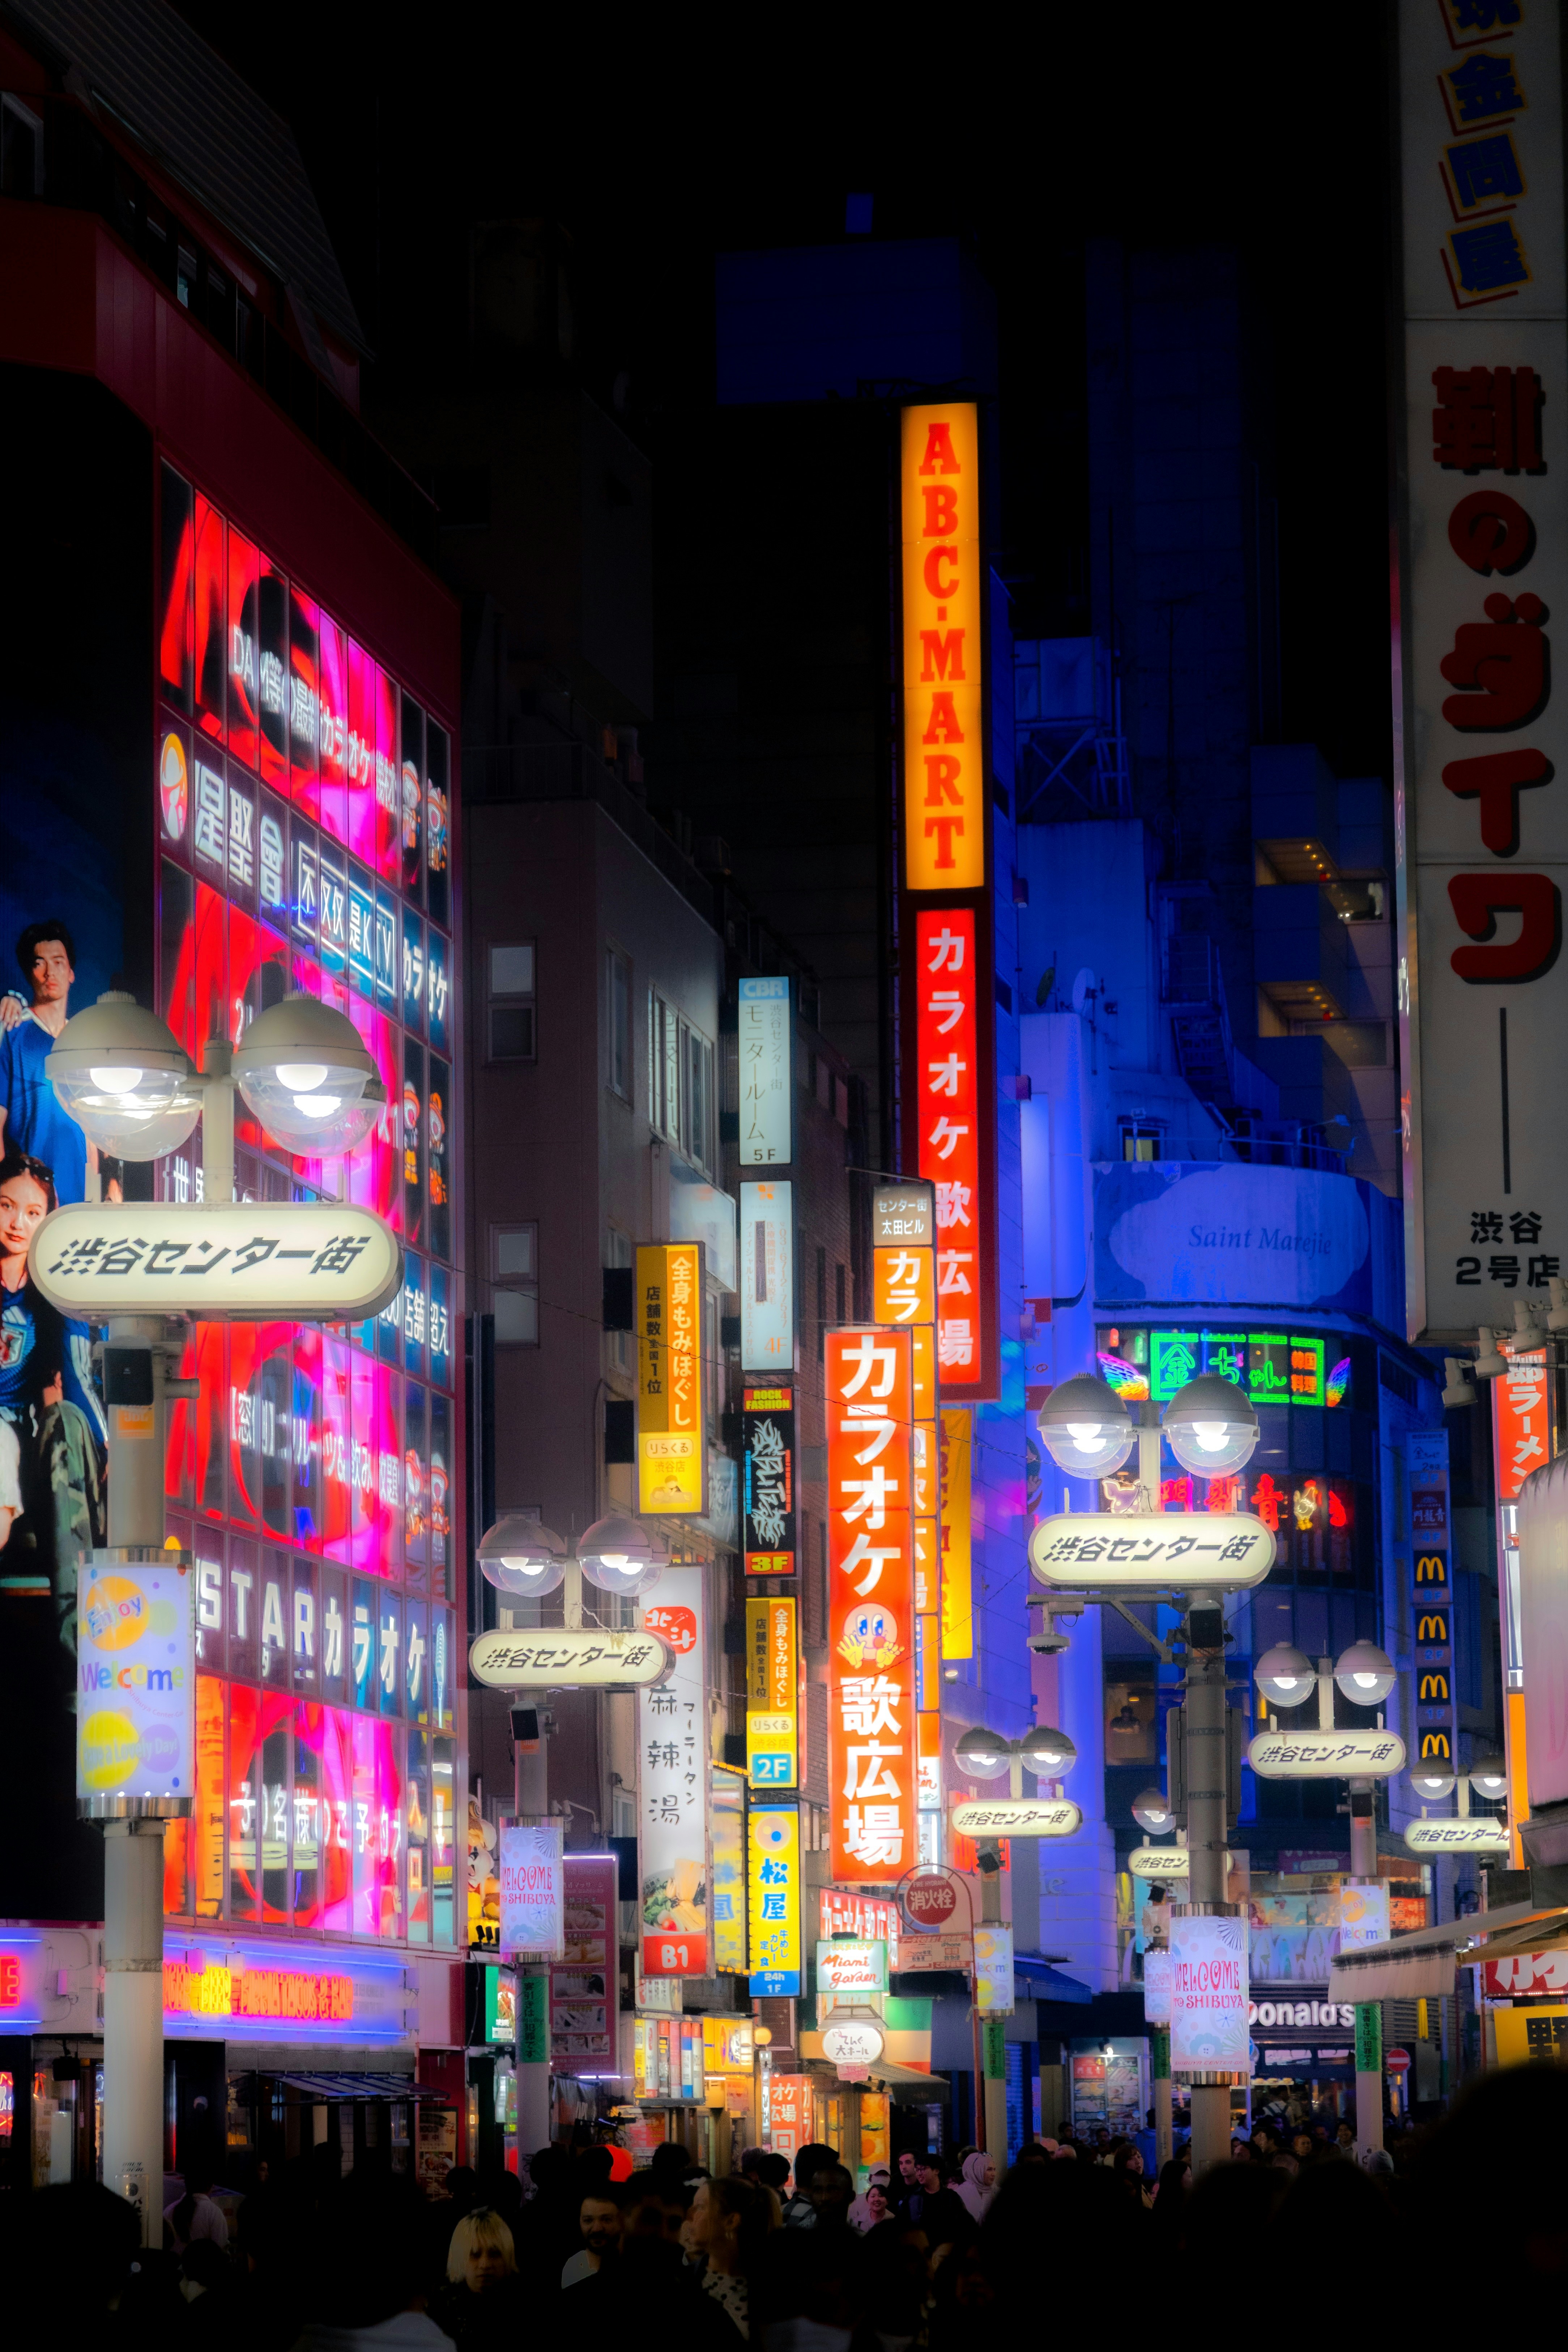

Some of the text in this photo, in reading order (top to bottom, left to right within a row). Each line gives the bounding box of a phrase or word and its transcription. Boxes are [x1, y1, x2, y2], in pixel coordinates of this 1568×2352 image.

[918, 422, 966, 869] ABC-MART
[743, 981, 783, 997] CBR
[770, 1004, 782, 1090] 渋谷センター街
[745, 1005, 766, 1140] モニタールーム
[754, 1149, 776, 1161] 5F
[927, 928, 973, 1366] カラオケ歌広場
[878, 1199, 928, 1213] センター街
[882, 1219, 924, 1235] 太田ビル
[1470, 1211, 1542, 1244] 渋谷
[1188, 1225, 1332, 1261] Saint Marejie
[48, 1235, 372, 1276] 渋谷センター街
[1456, 1254, 1560, 1288] 2号店
[670, 1256, 693, 1426] 全身もみほぐし
[763, 1337, 787, 1353] 4F
[746, 1399, 790, 1410] FASHION
[753, 1389, 783, 1400] ROCK
[649, 1443, 689, 1454] りらくる
[655, 1461, 686, 1473] 渋谷店
[840, 1335, 901, 1597] カラオケ
[1043, 1534, 1260, 1562] 渋谷センター街
[751, 1556, 788, 1572] 3F
[86, 1593, 143, 1641] Enjoy
[199, 1562, 314, 1656] STAR
[324, 1598, 425, 1701] カラオケ
[481, 1645, 654, 1669] 渋谷センター街
[775, 1609, 788, 1708] 全身もみほぐし
[1424, 1649, 1444, 1660] 2F
[81, 1661, 184, 1693] Welcome
[754, 1720, 789, 1730] りらくる
[648, 1684, 679, 1826] 麻辣湯
[683, 1702, 696, 1805] マーラータン
[1258, 1743, 1396, 1763] 渋谷センター街
[757, 1759, 787, 1778] 2F
[840, 1675, 904, 1867] 歌広場
[958, 1809, 1071, 1825] 渋谷センター街
[1135, 1857, 1188, 1869] 渋谷セン
[501, 1866, 552, 1891] WELCOME
[759, 1858, 788, 1920] 松屋
[508, 1893, 556, 1905] SHIBUYA
[910, 1888, 954, 1911] 消火栓
[779, 1929, 788, 1958] 牛めし
[1341, 1926, 1384, 1940] Welcome
[661, 1944, 688, 1968] B1
[760, 1941, 769, 1966] 定食
[770, 1934, 778, 1962] カレー
[820, 1955, 870, 1968] Miami
[764, 1973, 785, 1981] 24h
[1173, 1960, 1239, 1992] WELCOME
[767, 1985, 781, 1994] 1F
[1186, 1995, 1244, 2009] SHIBUYA
[835, 2045, 869, 2056] 大ホール
